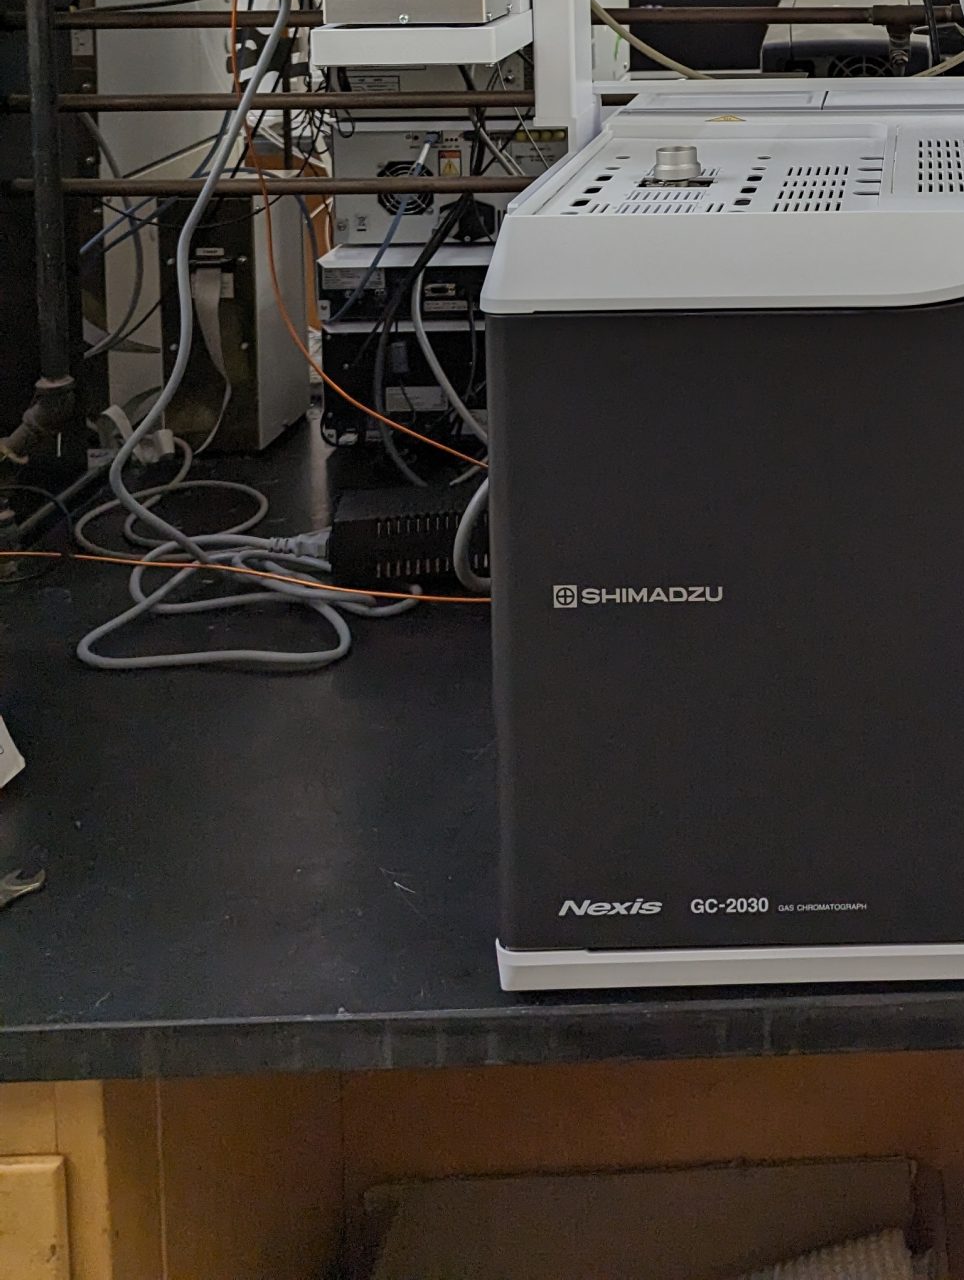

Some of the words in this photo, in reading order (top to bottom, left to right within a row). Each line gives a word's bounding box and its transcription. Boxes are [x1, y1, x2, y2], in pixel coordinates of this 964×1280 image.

[581, 586, 723, 605] SHIMADZU
[558, 898, 663, 917] Nexis
[690, 898, 769, 914] GC-2030
[778, 904, 794, 912] GAS
[796, 903, 867, 912] CHROMATOGRAPH
